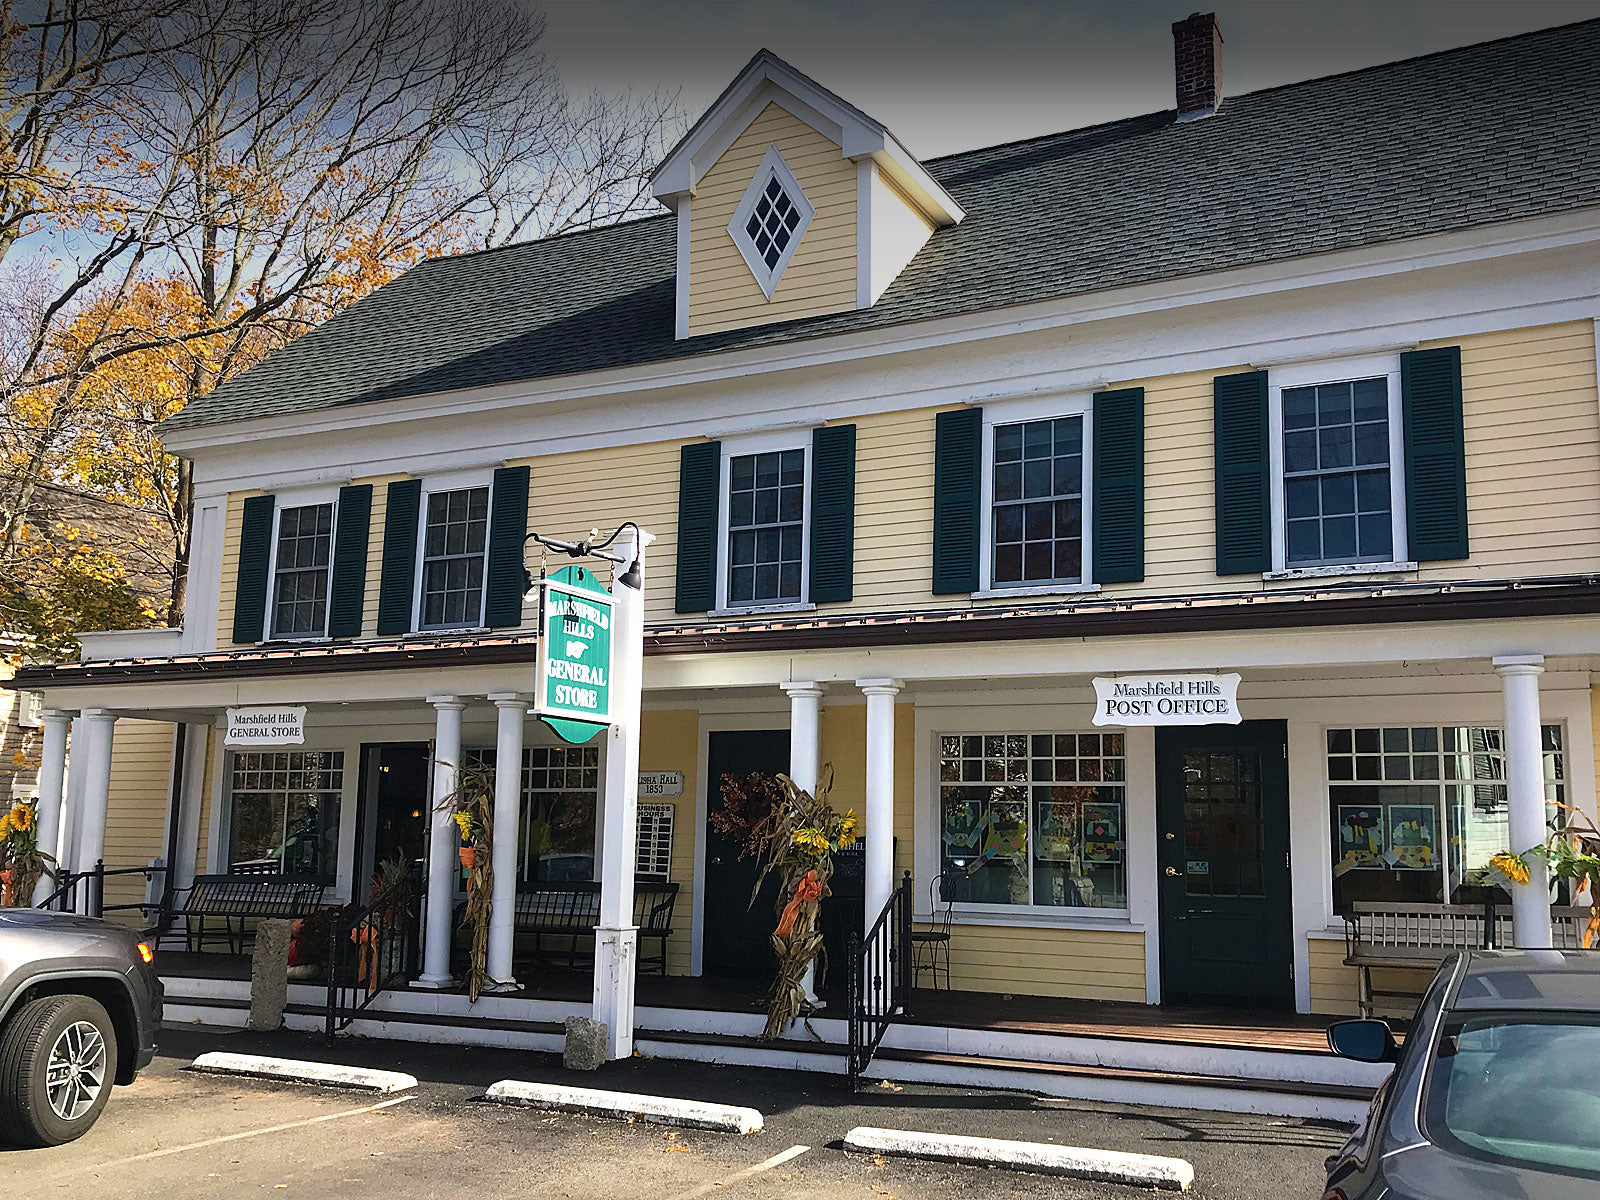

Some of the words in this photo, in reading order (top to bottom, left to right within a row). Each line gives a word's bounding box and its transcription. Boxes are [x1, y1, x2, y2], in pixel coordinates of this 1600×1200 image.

[563, 620, 595, 640] HILLS
[547, 658, 607, 687] GENERAL
[555, 685, 598, 709] STORE
[1113, 681, 1184, 697] Marshfield
[1187, 680, 1221, 696] Hills
[1105, 699, 1152, 716] POST
[1157, 698, 1229, 716] OFFICE
[234, 714, 276, 725] Marshfield
[278, 713, 298, 724] Hills
[229, 728, 270, 738] GENERAL
[271, 727, 300, 737] STORE
[660, 774, 678, 785] HALL
[645, 784, 664, 794] 1853
